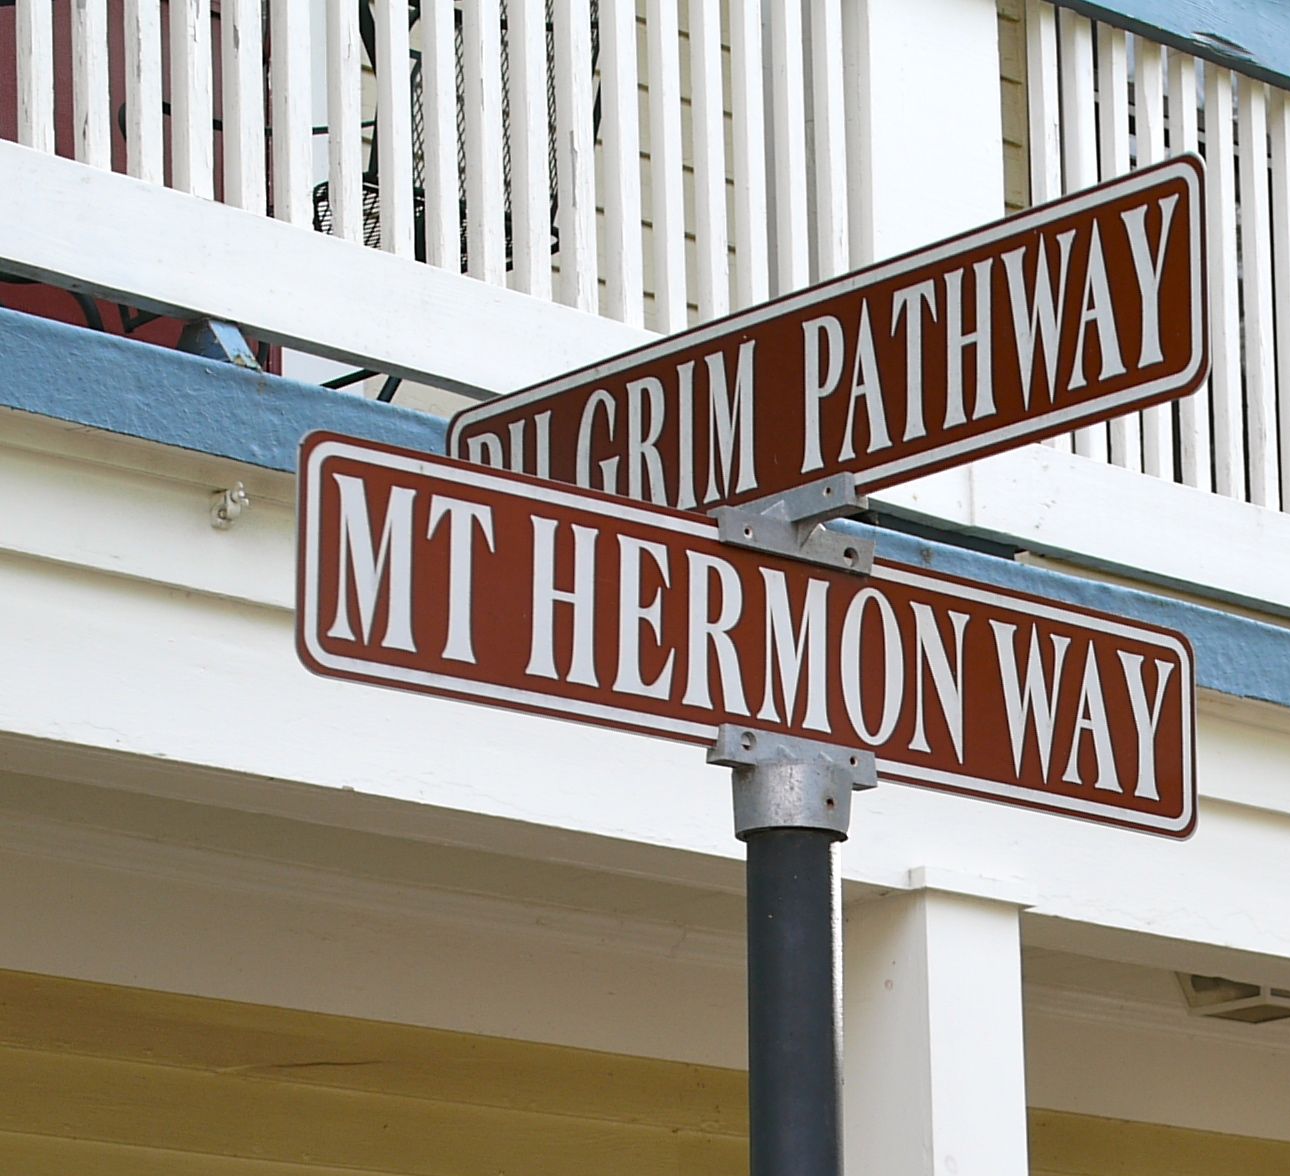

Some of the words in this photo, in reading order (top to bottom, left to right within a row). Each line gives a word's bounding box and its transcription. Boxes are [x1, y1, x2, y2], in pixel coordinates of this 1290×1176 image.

[467, 337, 757, 511] GRIM
[801, 193, 1179, 475] PATHWAY
[326, 473, 495, 664] MT
[526, 513, 971, 765] HERMON
[988, 616, 1175, 803] WAY
